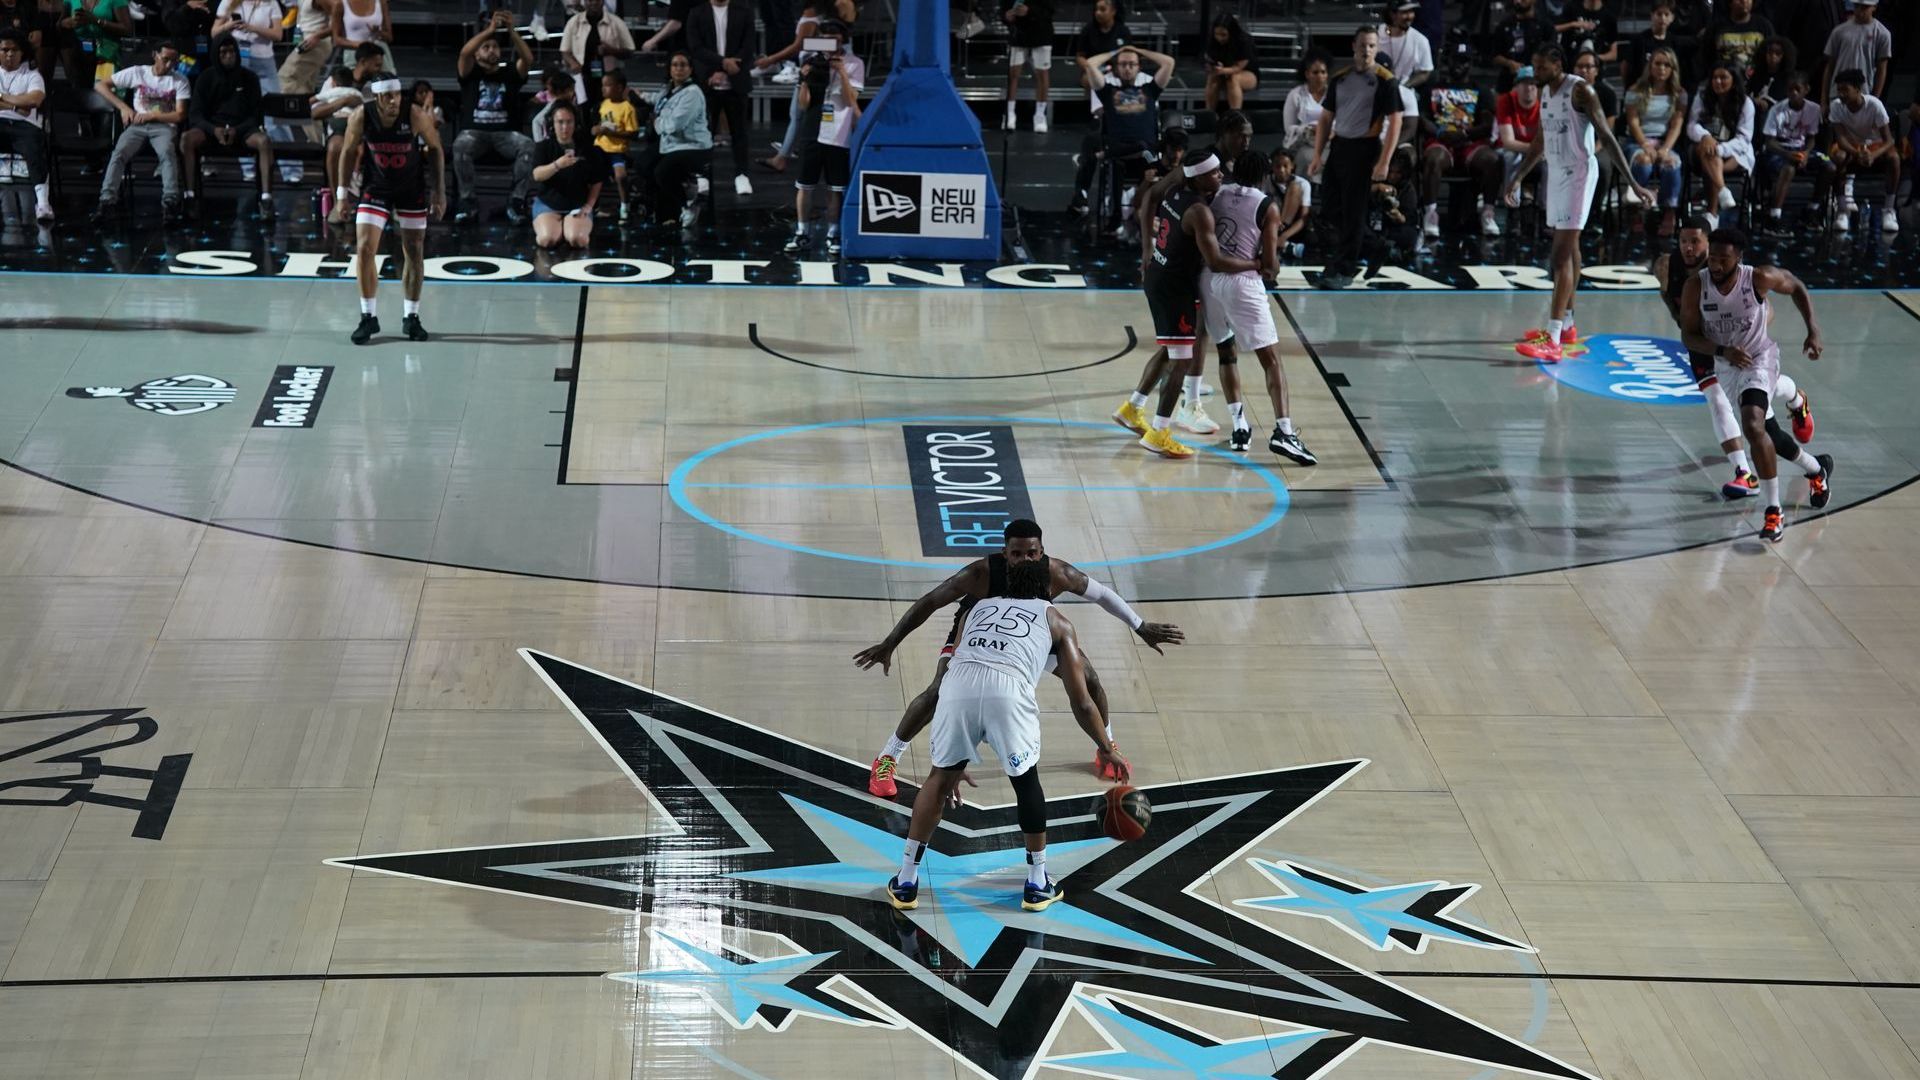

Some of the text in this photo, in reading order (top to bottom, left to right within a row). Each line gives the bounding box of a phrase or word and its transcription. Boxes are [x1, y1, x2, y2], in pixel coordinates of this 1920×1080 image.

[931, 187, 976, 206] NEW
[931, 206, 975, 224] ERA
[168, 250, 1663, 290] SHOOTING TARS
[1609, 339, 1705, 399] Rubicon
[263, 366, 325, 427] Foot Locker
[963, 605, 1038, 638] 25
[967, 636, 1009, 652] GRAY
